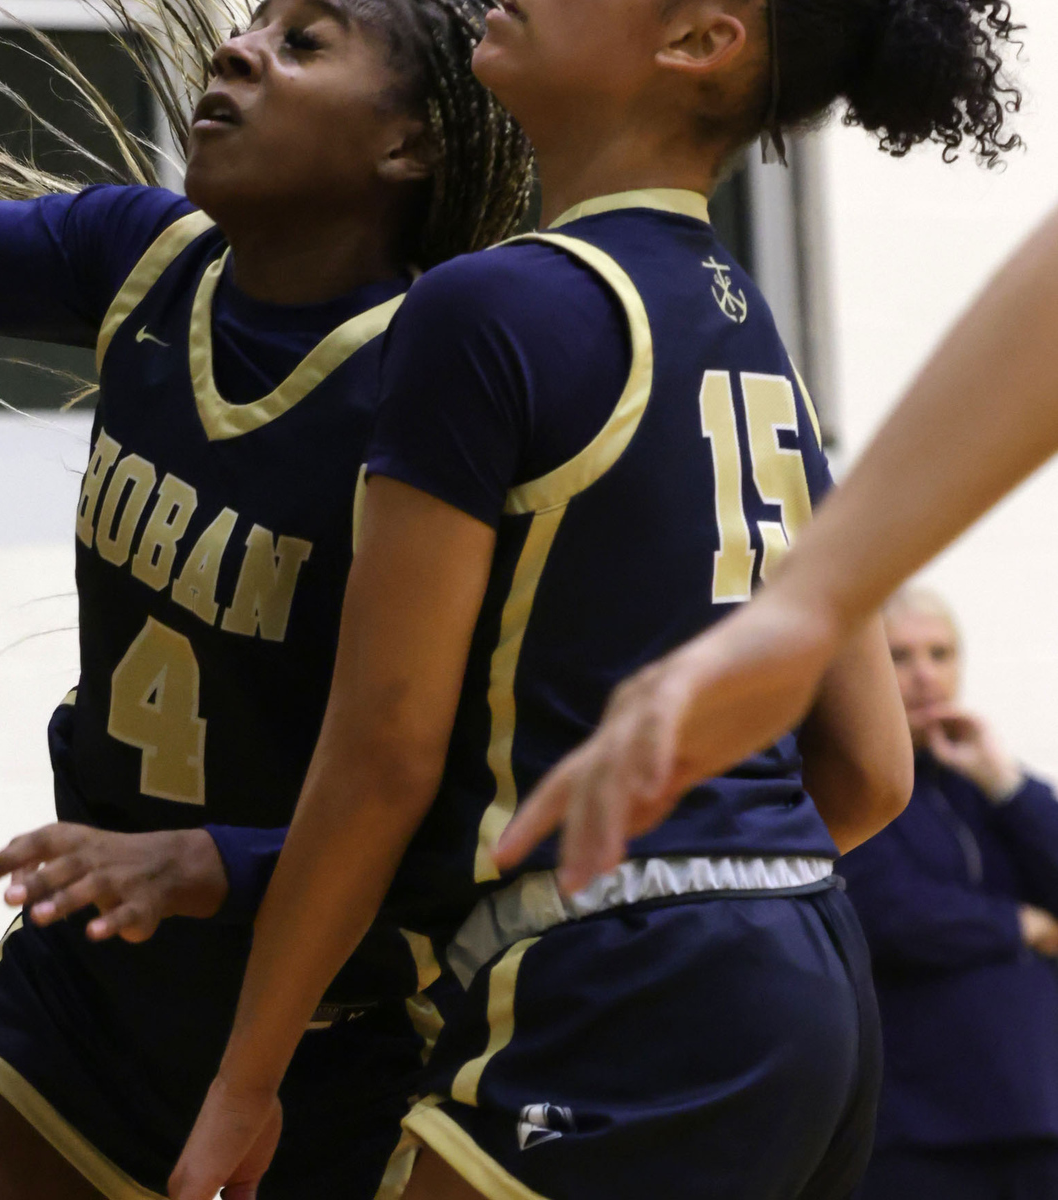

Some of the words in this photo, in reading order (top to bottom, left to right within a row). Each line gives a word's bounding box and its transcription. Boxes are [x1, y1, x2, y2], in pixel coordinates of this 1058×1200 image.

[76, 427, 313, 642] HOBAN
[699, 369, 813, 604] 15
[107, 614, 208, 806] 4
